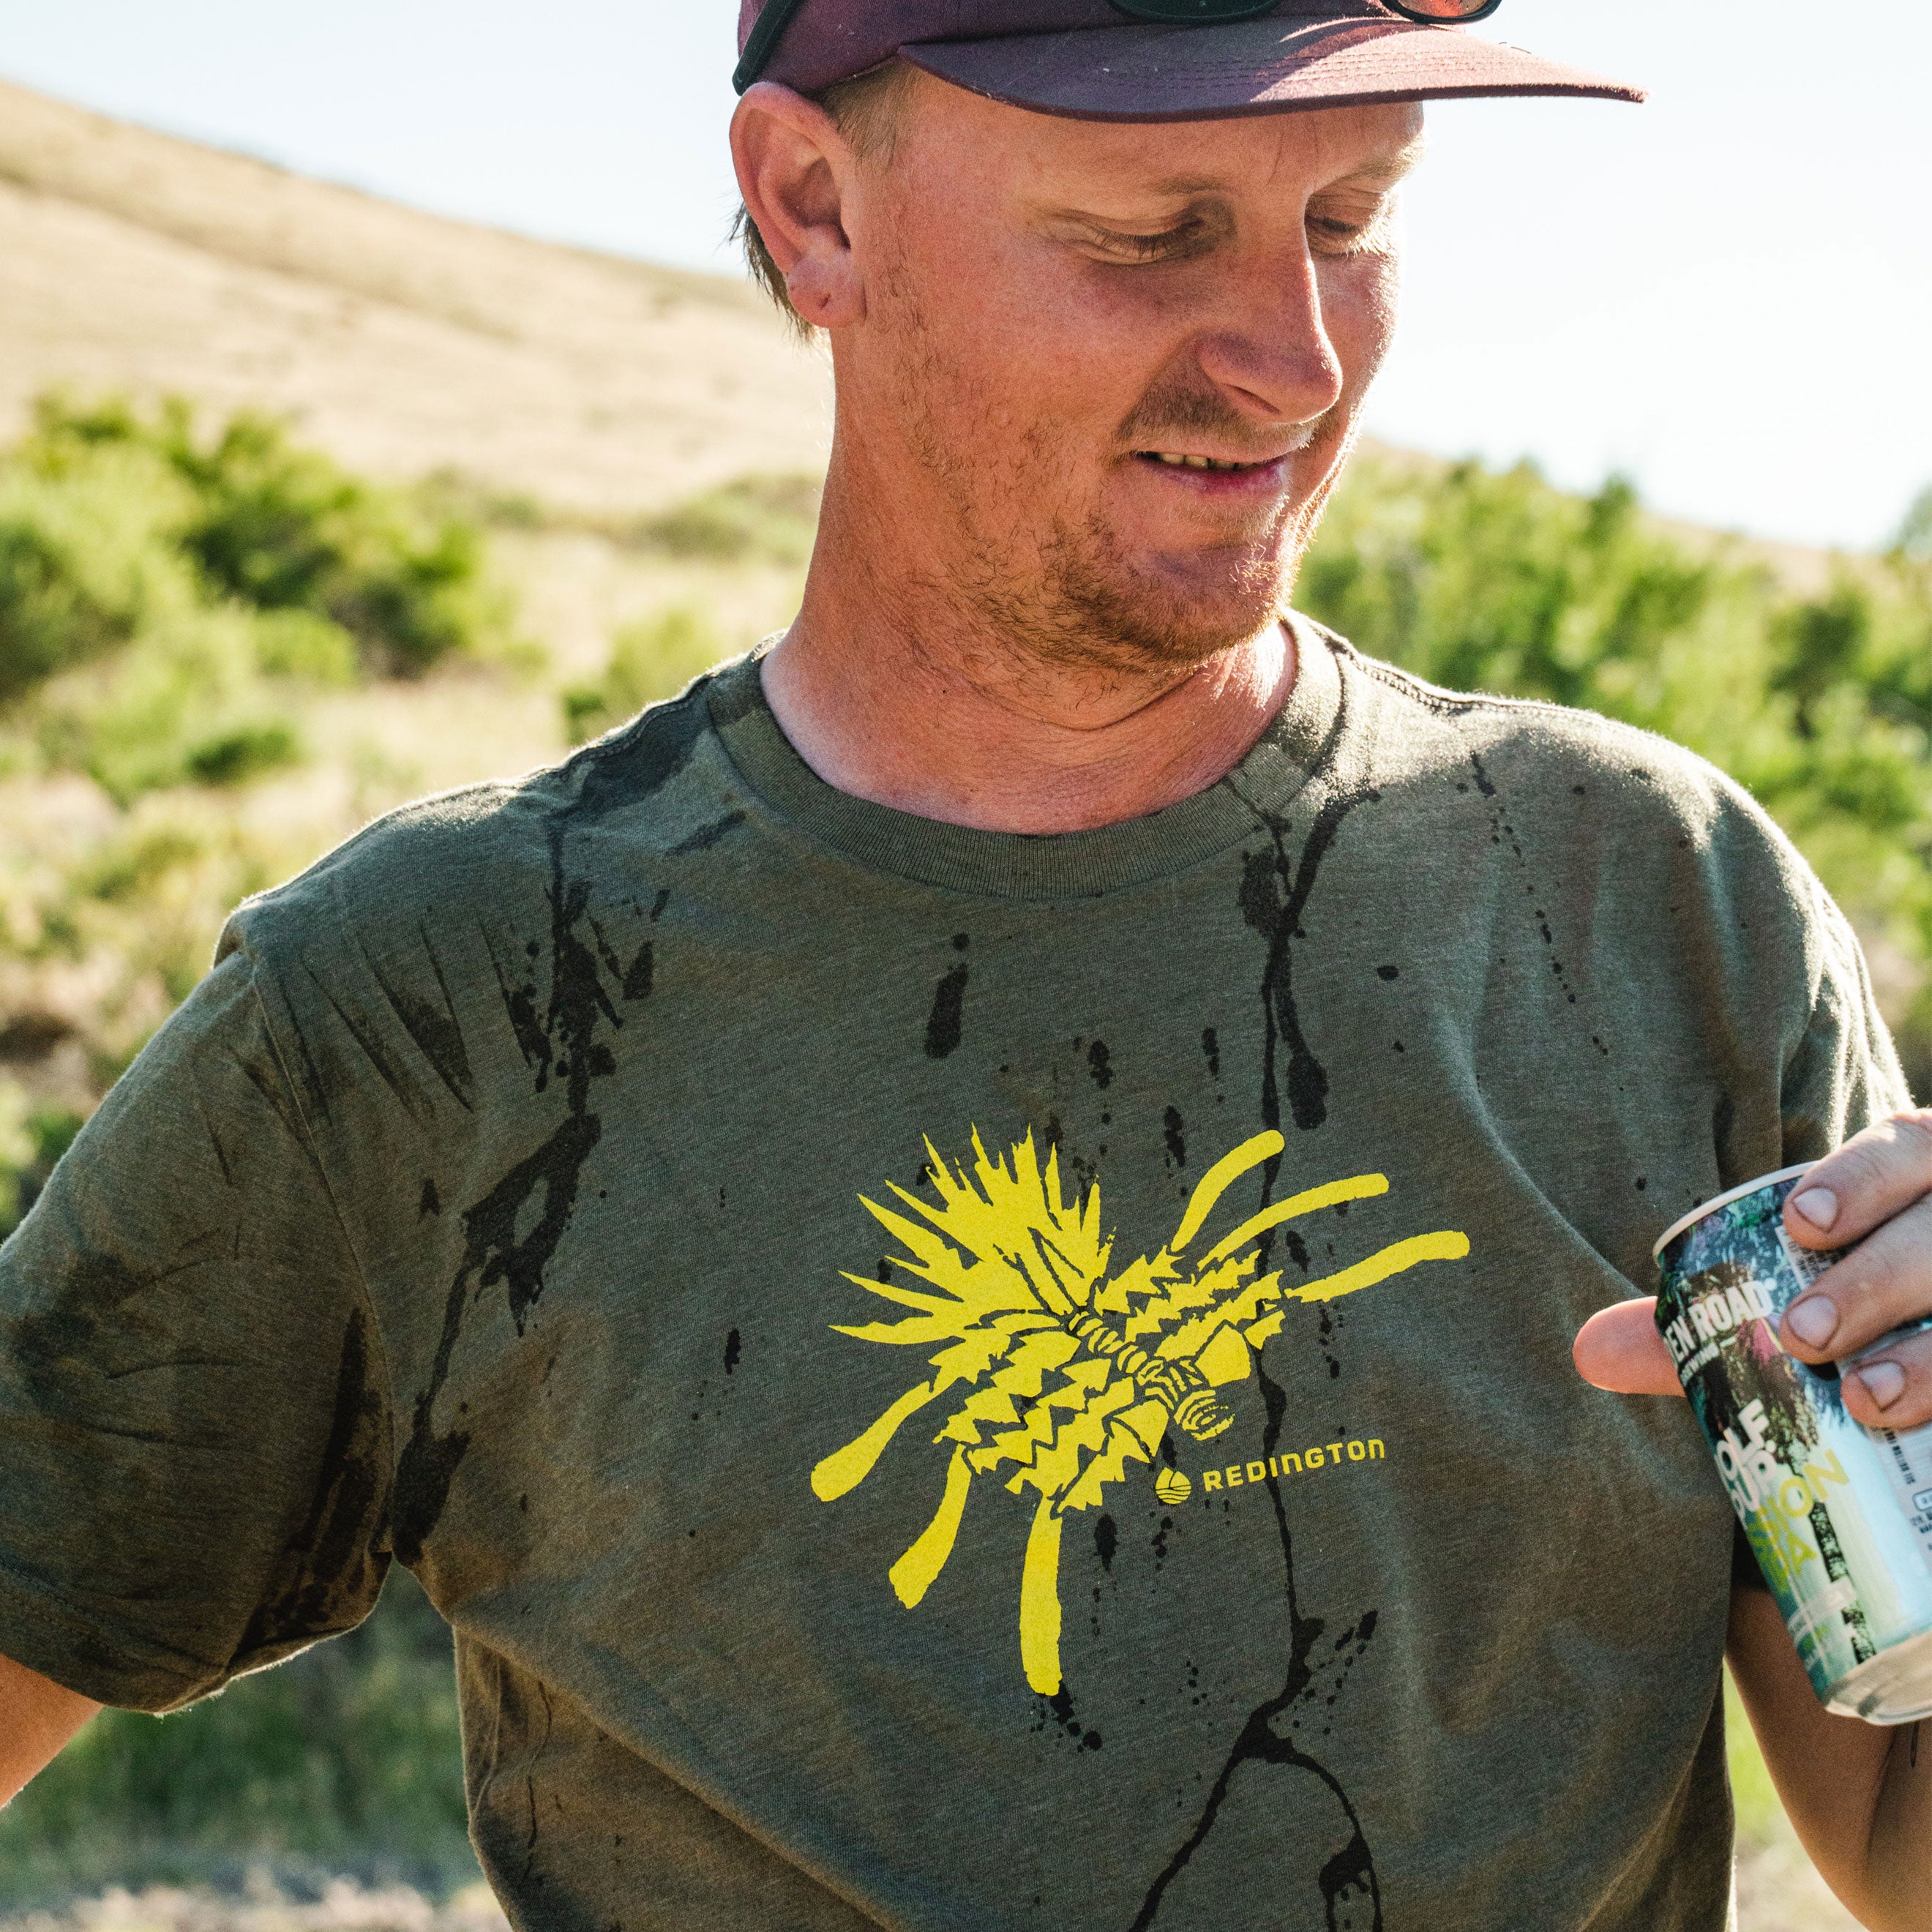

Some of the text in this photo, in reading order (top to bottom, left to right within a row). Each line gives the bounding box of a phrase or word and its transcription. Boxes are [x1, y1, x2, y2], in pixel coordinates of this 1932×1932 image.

[1688, 1281, 1773, 1342] ROAD
[1203, 1439, 1385, 1492] REDINGTON
[1715, 1399, 1770, 1493] OLF
